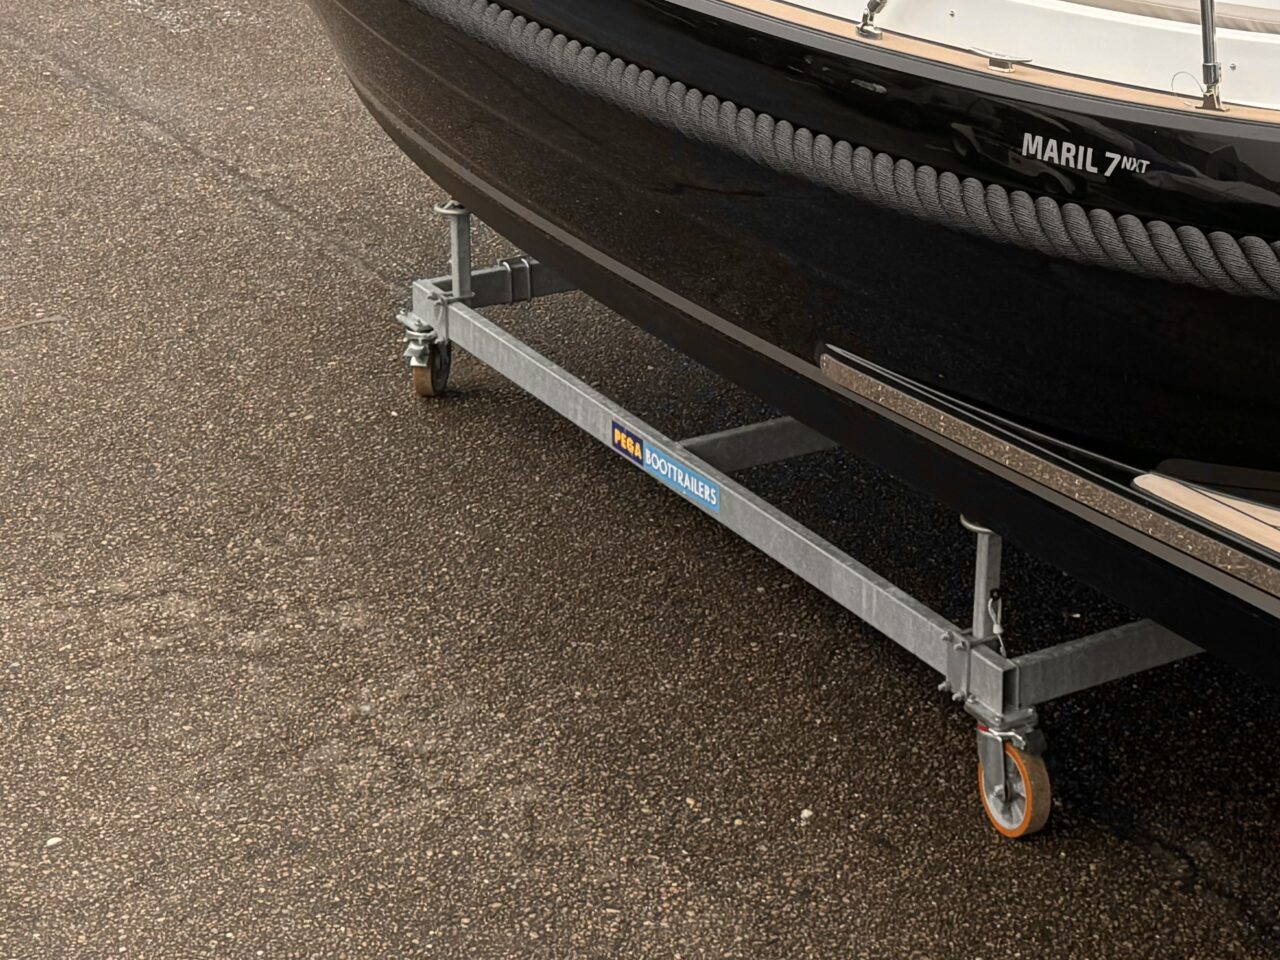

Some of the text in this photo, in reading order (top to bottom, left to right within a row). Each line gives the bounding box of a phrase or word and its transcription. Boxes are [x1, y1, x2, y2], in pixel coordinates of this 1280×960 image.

[1021, 132, 1099, 174] MARIL
[614, 428, 717, 505] PEGA BOOTTRAILERS
